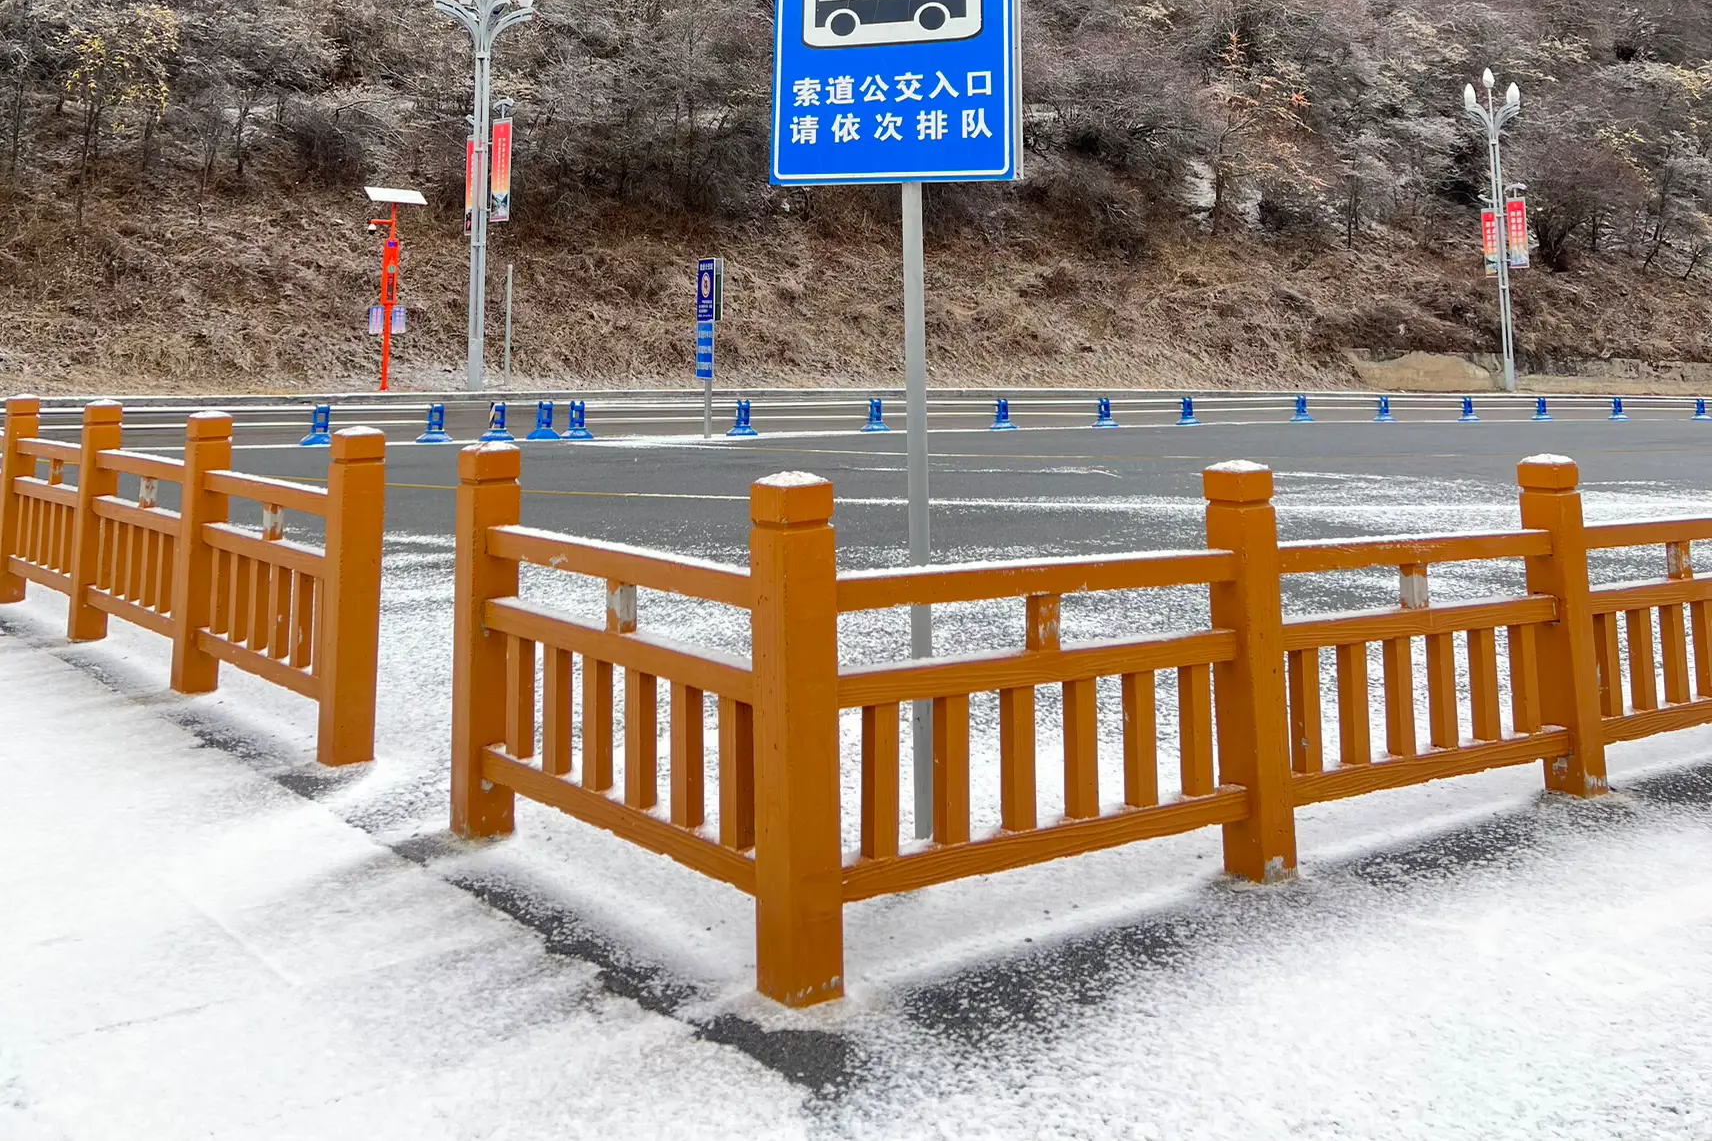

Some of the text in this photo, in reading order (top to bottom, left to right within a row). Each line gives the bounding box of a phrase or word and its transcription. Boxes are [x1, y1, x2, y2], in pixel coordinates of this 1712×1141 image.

[792, 70, 992, 107] 索道公交入口
[789, 108, 993, 145] 请依次排队
